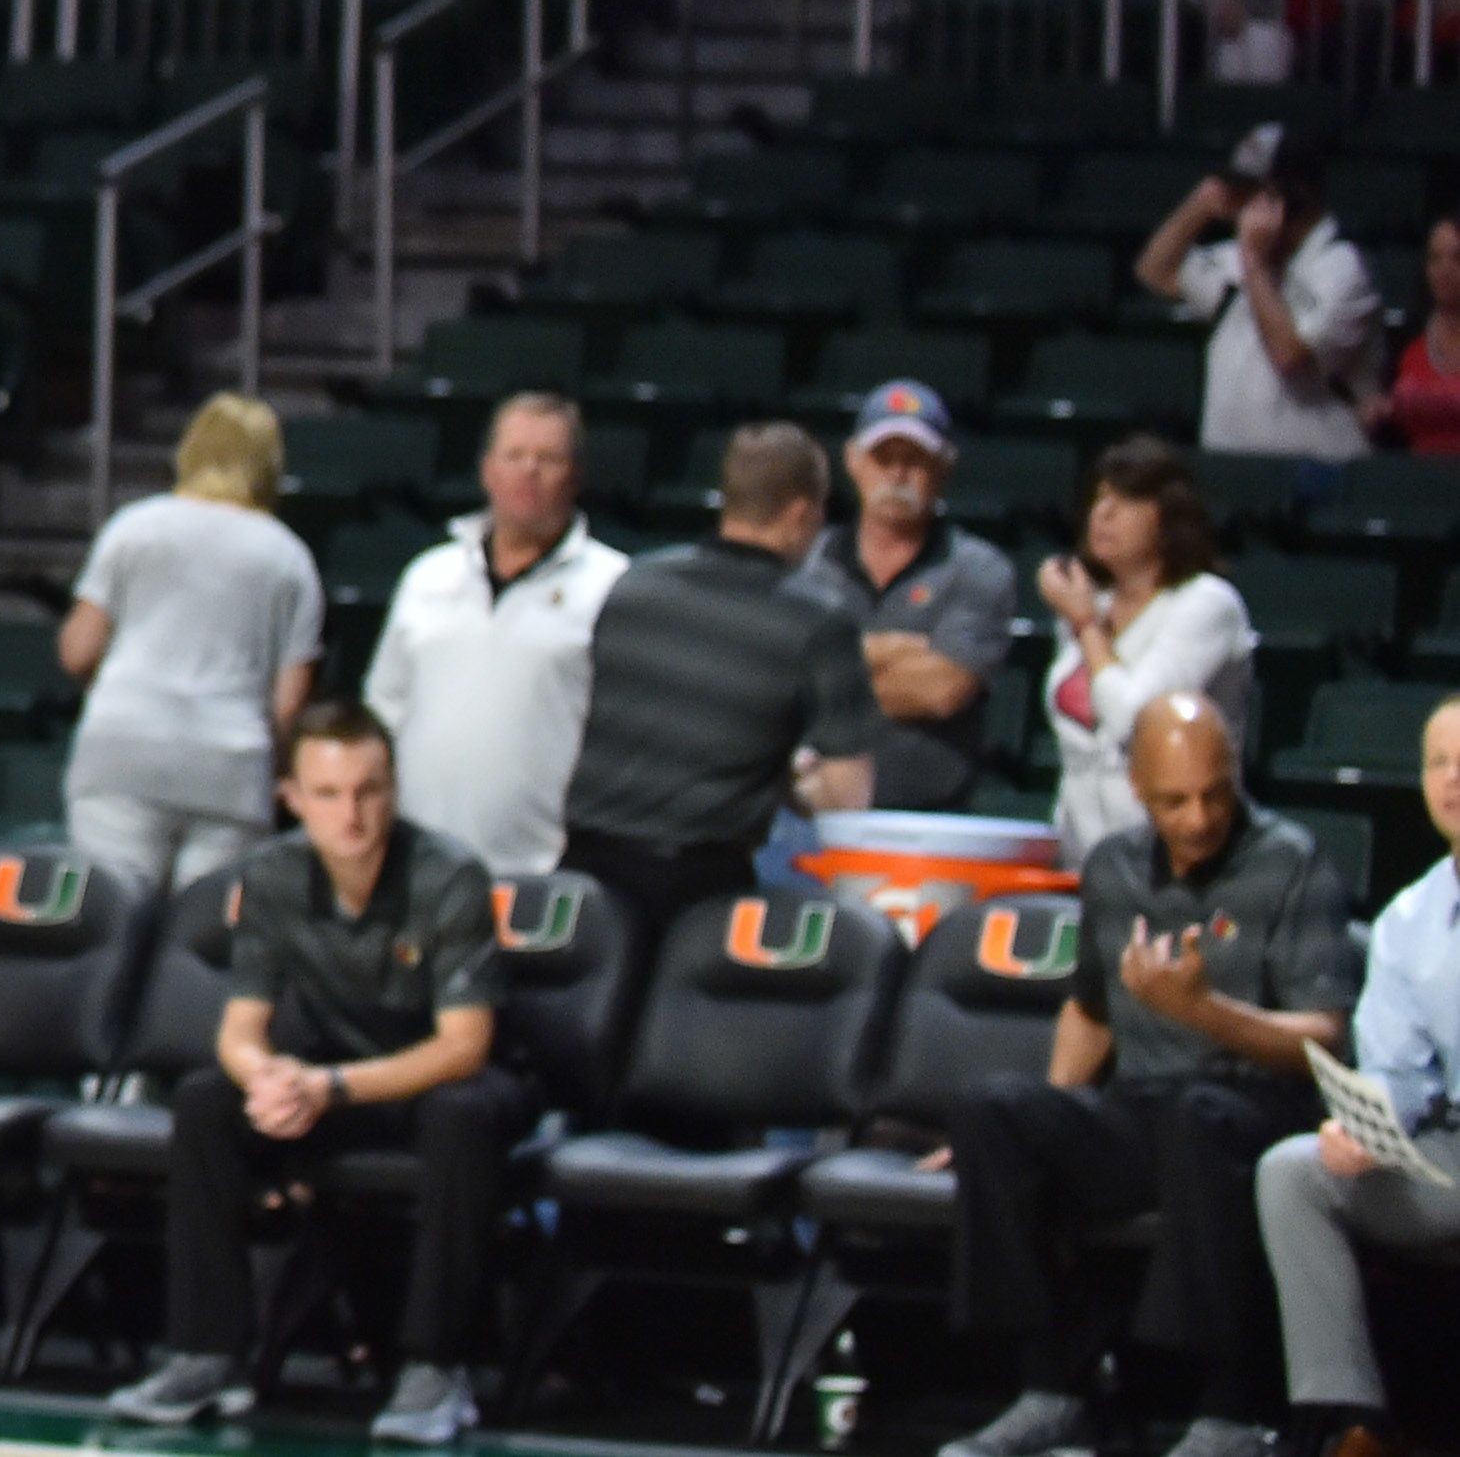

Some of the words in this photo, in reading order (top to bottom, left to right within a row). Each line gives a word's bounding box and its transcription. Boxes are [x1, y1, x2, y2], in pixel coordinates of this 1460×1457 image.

[490, 880, 584, 952] U
[725, 898, 836, 969] U
[977, 906, 1080, 980] U
